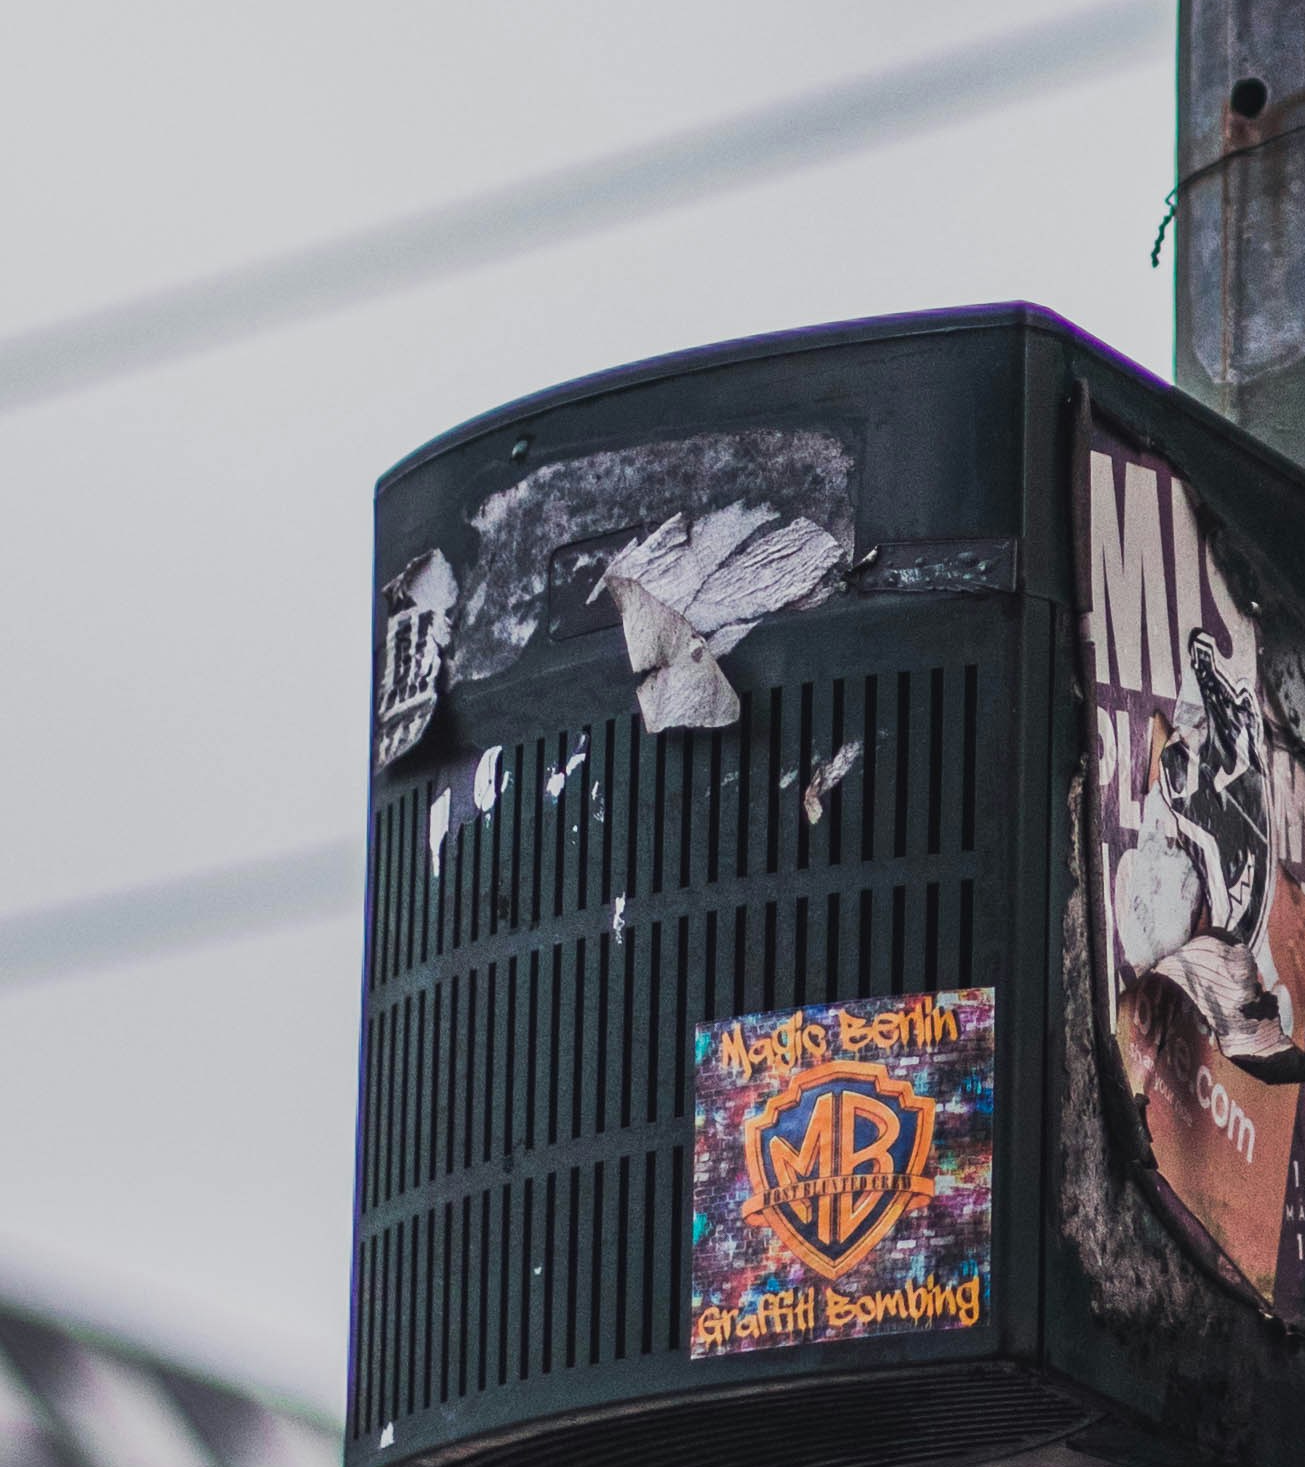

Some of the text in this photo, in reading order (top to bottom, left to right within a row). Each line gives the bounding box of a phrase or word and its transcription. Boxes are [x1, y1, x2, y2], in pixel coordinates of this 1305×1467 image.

[720, 996, 958, 1082] Magic Berlin
[768, 1090, 901, 1245] MB
[698, 1276, 980, 1348] Graffiti Bombing
